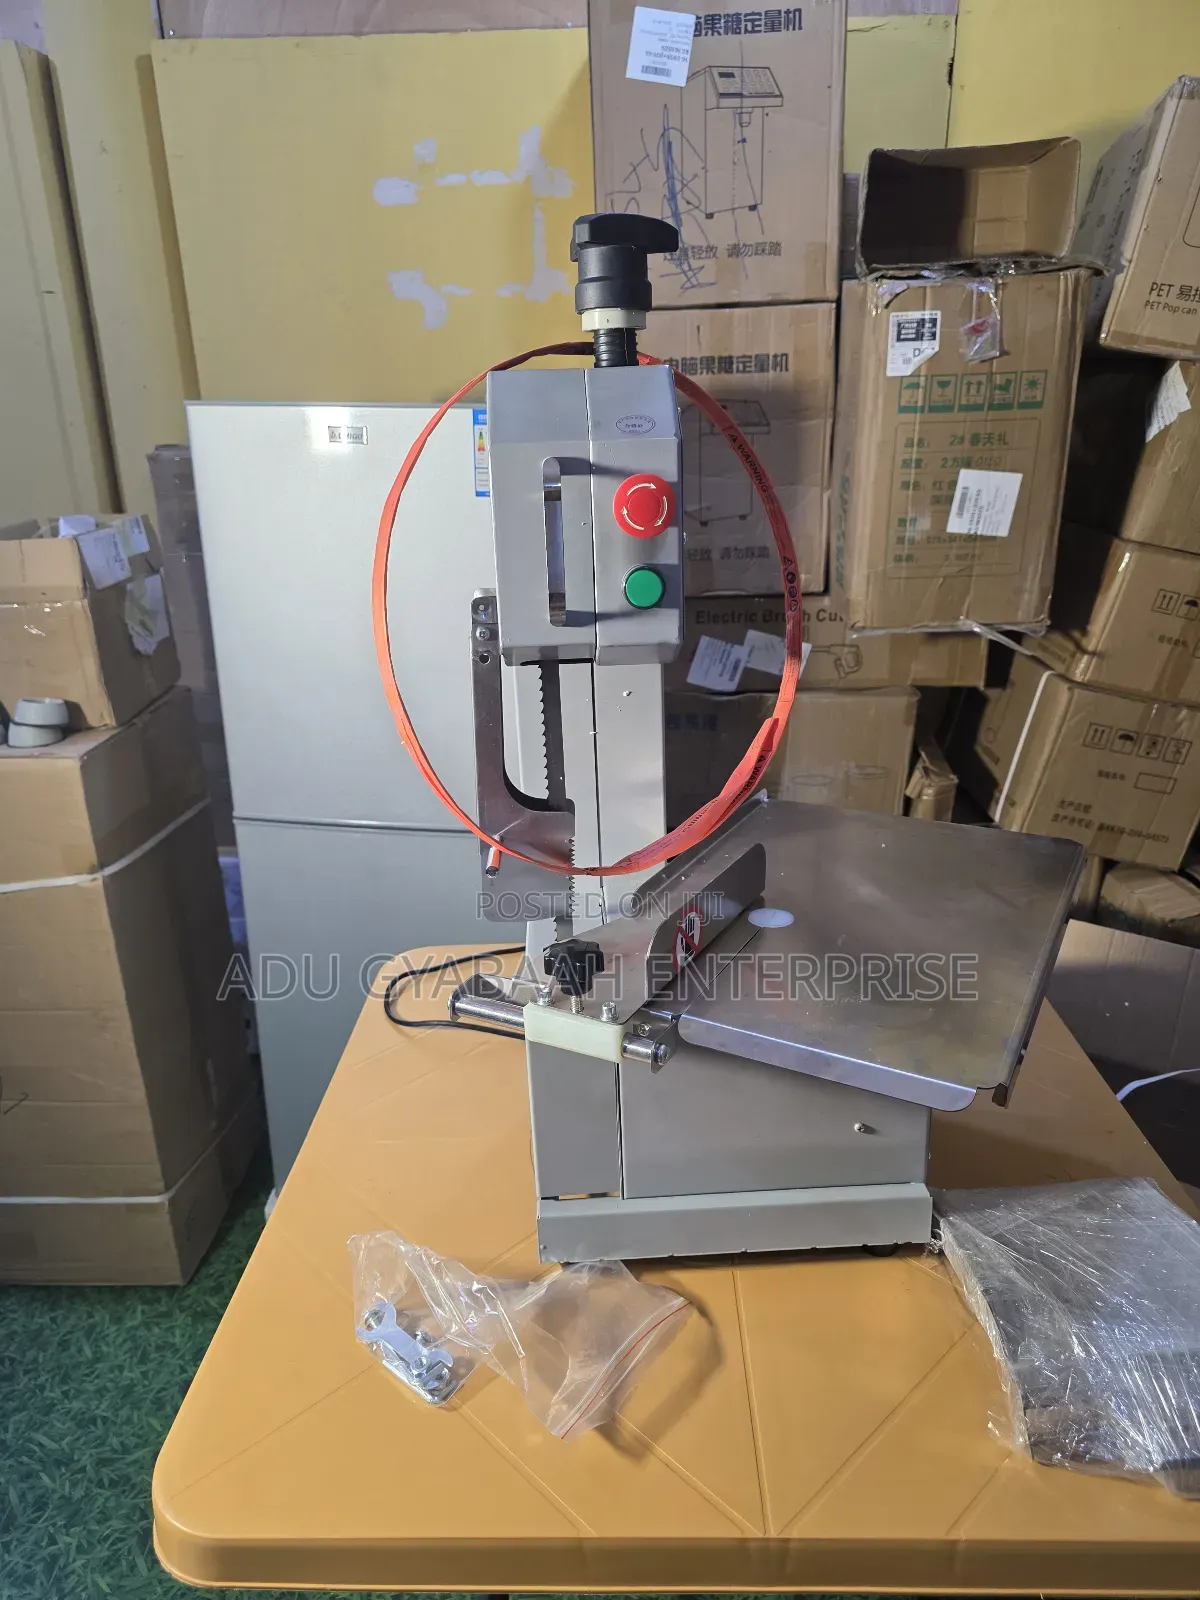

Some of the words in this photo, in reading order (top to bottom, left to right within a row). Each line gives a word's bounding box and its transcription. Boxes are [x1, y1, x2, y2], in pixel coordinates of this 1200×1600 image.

[1149, 282, 1175, 298] PET
[1144, 300, 1162, 311] PET
[1162, 302, 1180, 315] Pop
[1181, 307, 1198, 315] can
[737, 445, 769, 494] WARNING
[696, 608, 758, 625] Electric
[762, 607, 811, 624] Brh
